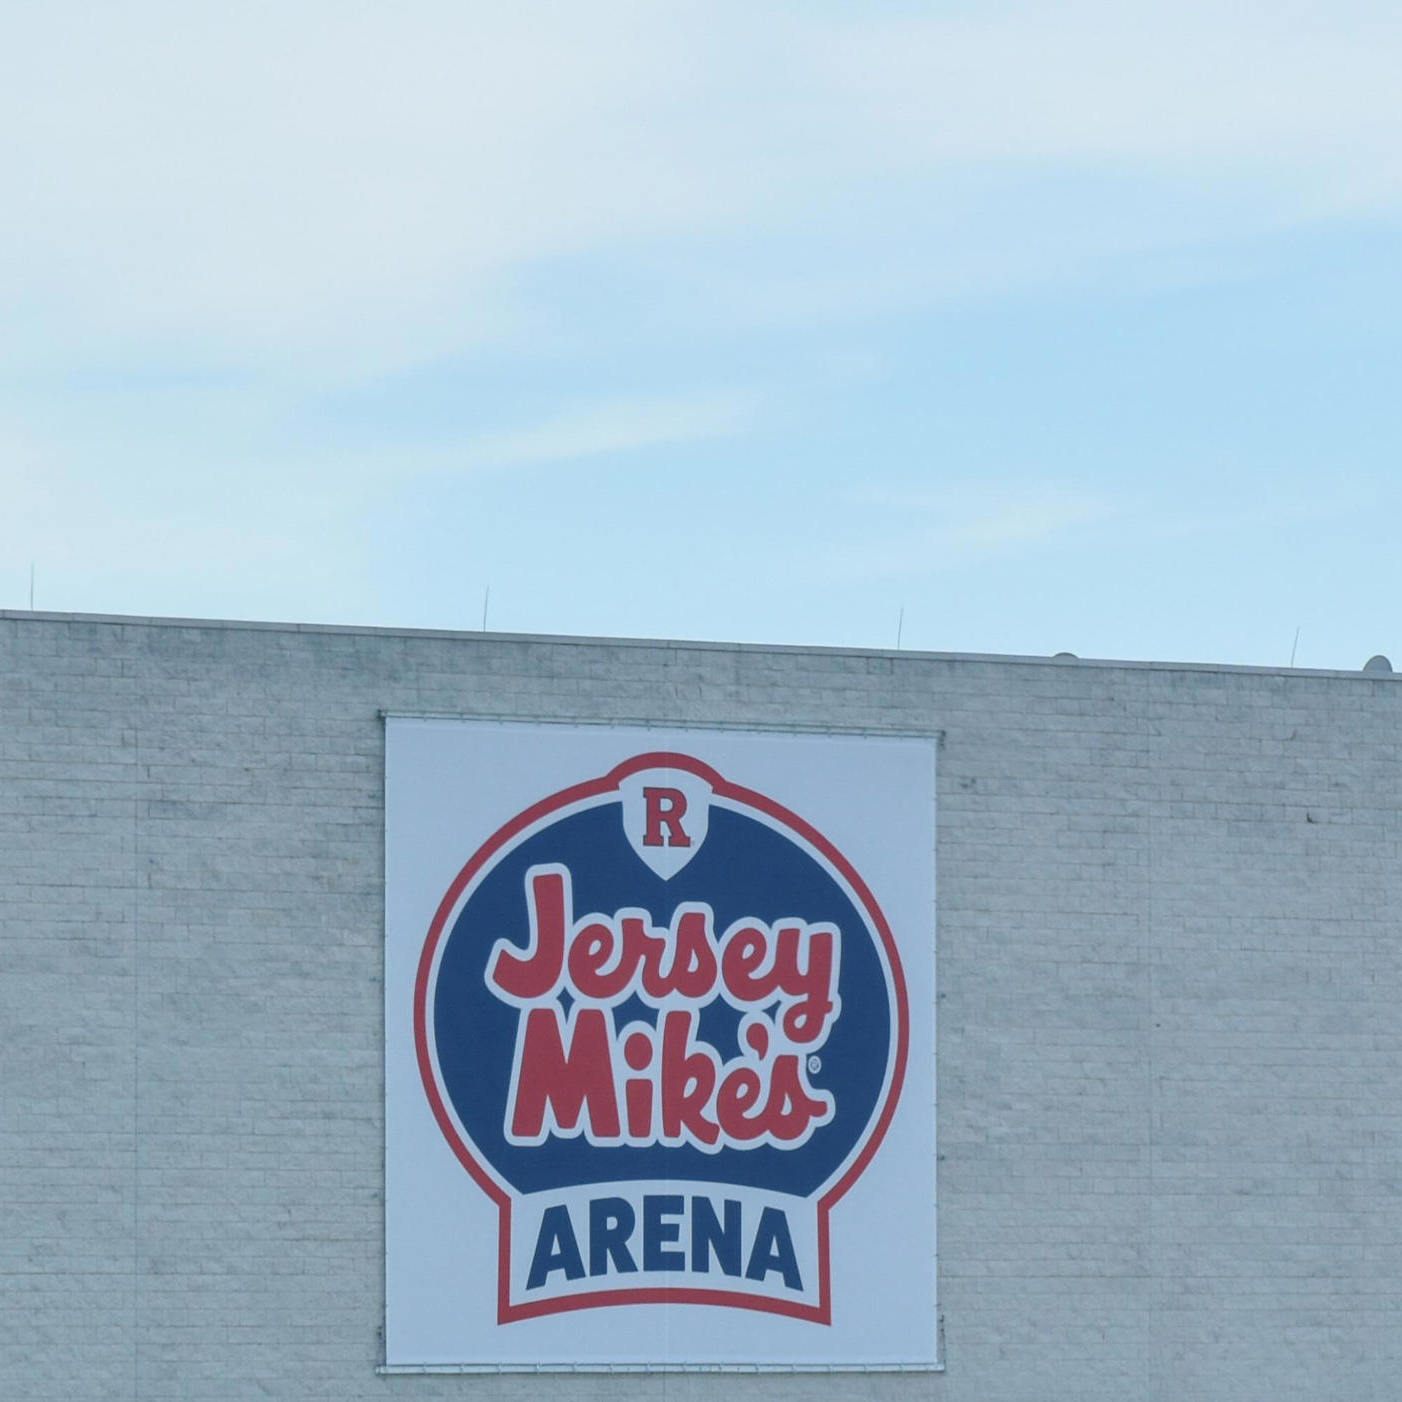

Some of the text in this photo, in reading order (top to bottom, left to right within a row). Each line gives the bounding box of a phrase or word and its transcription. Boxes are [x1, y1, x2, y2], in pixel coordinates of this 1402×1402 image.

[642, 786, 692, 848] R
[489, 869, 837, 1045] Jersey
[508, 1005, 830, 1147] Mike's
[526, 1195, 804, 1291] ARENA
